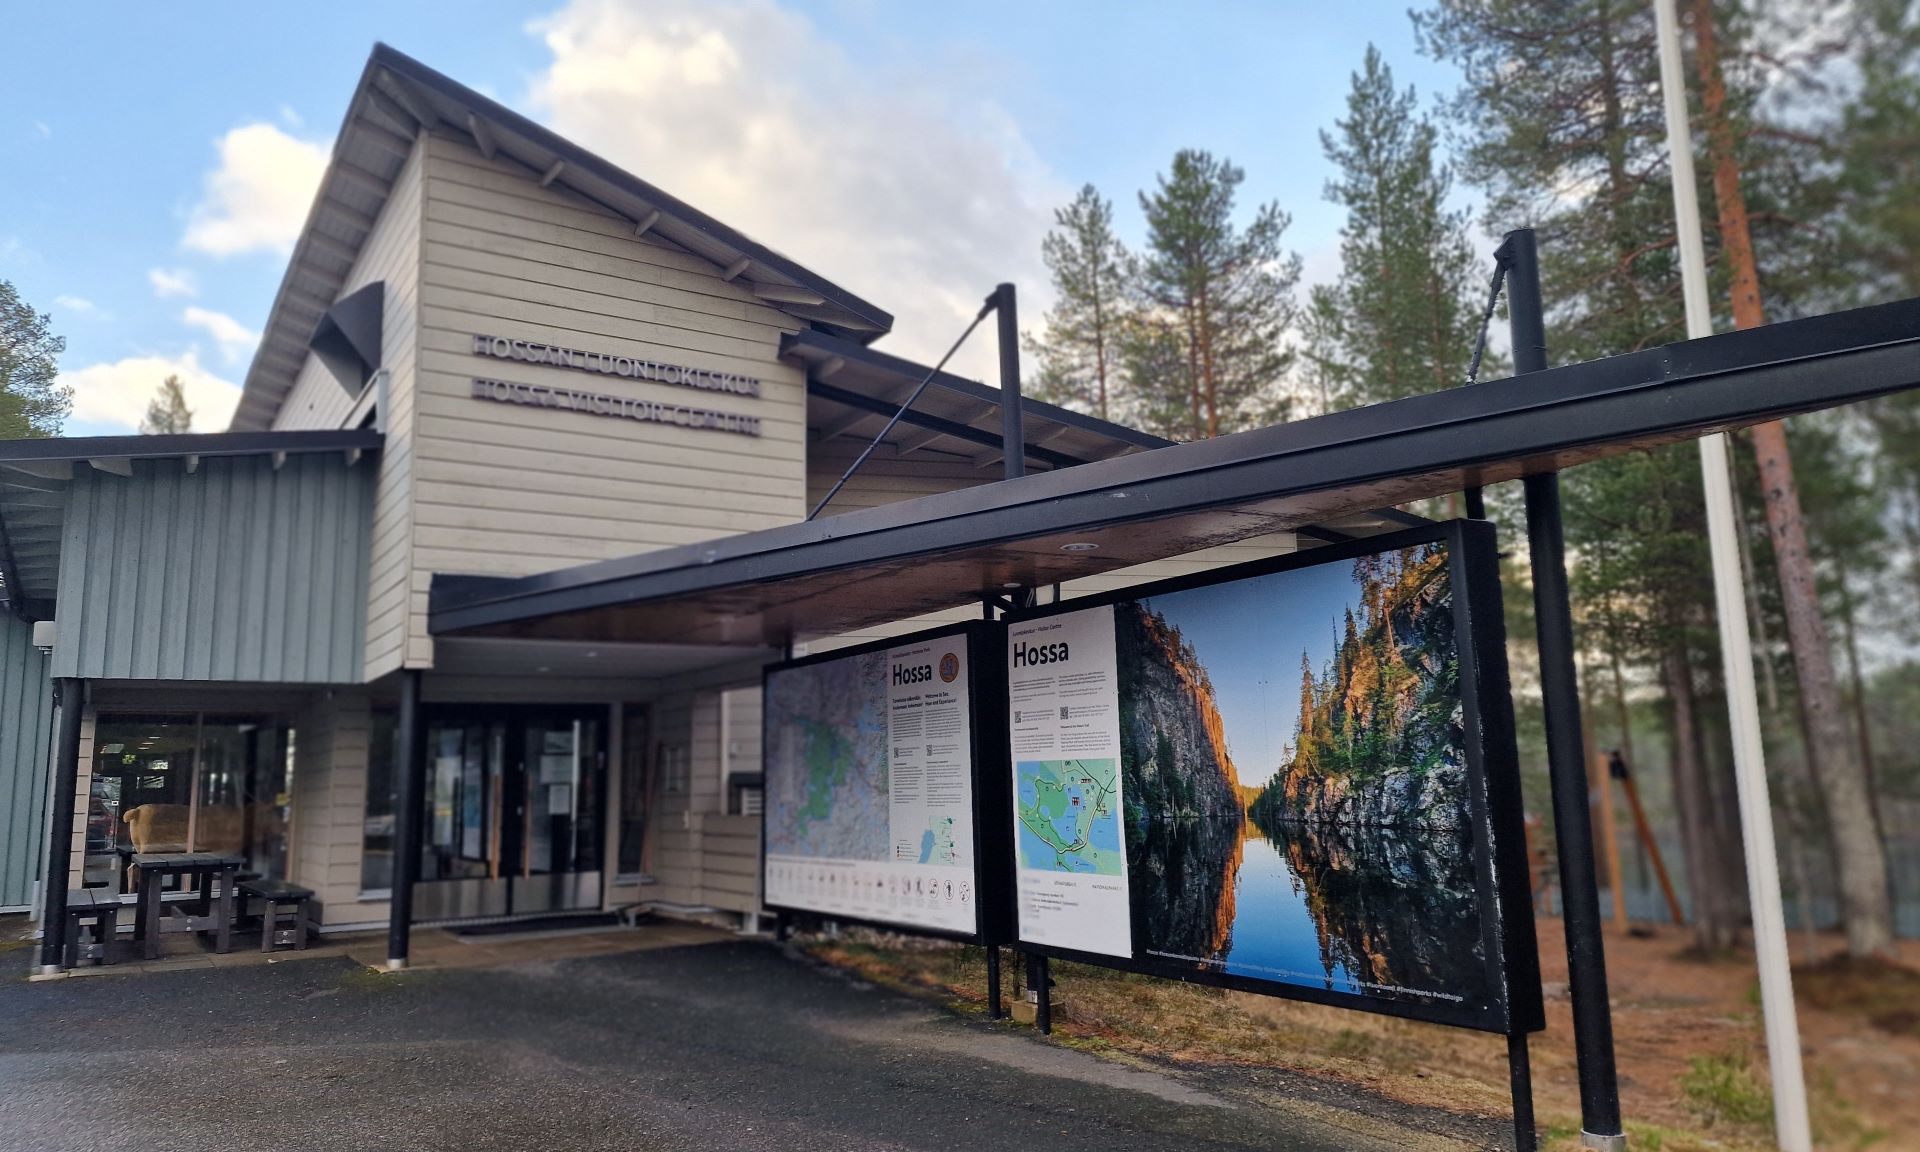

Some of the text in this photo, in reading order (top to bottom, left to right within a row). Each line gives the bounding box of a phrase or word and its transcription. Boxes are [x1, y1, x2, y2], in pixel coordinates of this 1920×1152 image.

[473, 335, 760, 397] HOSSAN LUONTOKESKUS
[472, 379, 560, 409] HOSSA
[568, 390, 664, 422] VISITOR
[1014, 642, 1069, 668] Hossa
[893, 664, 932, 686] Hossa
